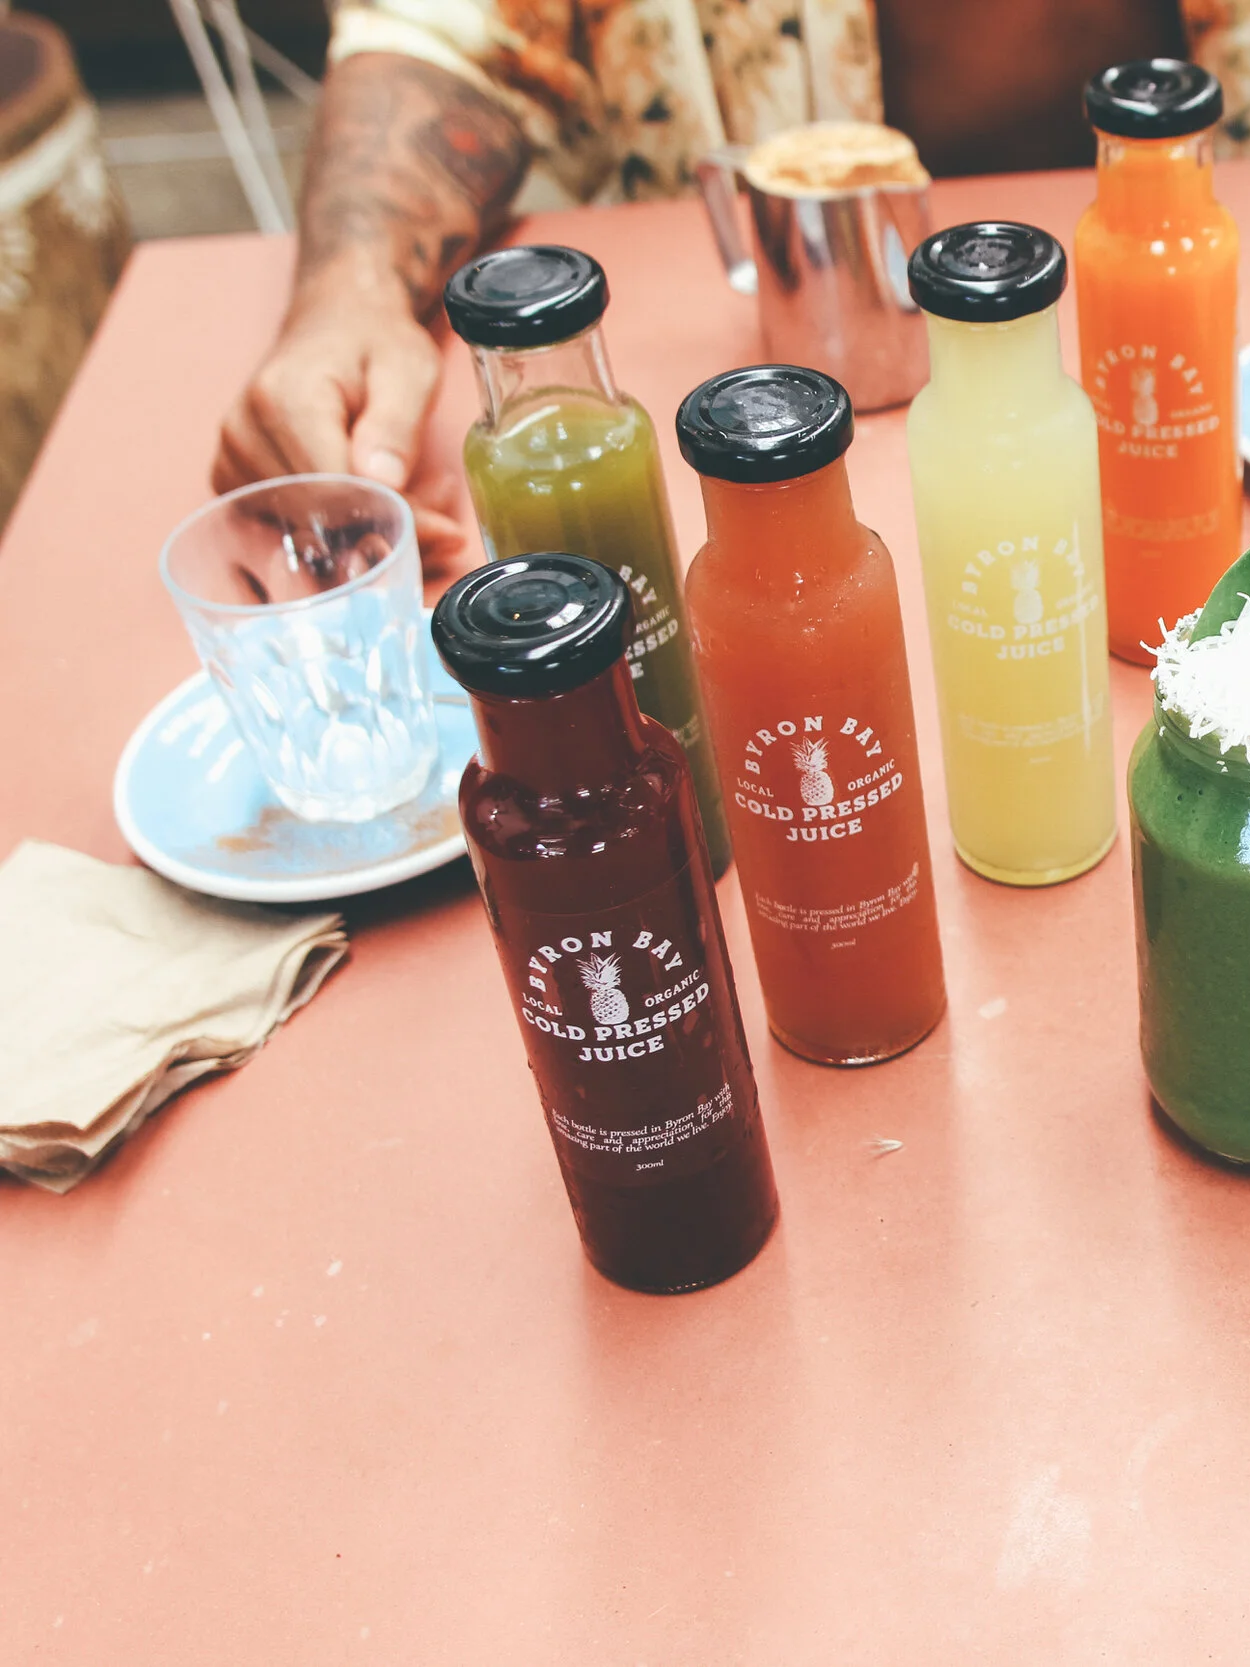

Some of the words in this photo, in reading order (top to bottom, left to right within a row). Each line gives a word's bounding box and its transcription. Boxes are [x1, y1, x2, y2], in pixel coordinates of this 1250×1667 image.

[1170, 354, 1204, 394] BAY
[1097, 412, 1125, 435] OLD
[1132, 415, 1220, 440] PRESSED
[1118, 441, 1178, 458] JUICE
[962, 537, 1038, 595] BYRON
[635, 605, 670, 635] RGANIC
[948, 614, 1005, 639] COLD
[996, 636, 1065, 660] JUICE
[745, 716, 823, 775] BYRON
[840, 717, 882, 758] BAY
[737, 777, 774, 798] LOCAL
[847, 758, 896, 791] ORGANIC
[735, 792, 794, 821] COLD
[802, 772, 903, 822] PRESSED
[786, 818, 863, 842] JUICE
[809, 905, 844, 917] pressed
[528, 931, 612, 992] BYRON
[632, 931, 683, 971] BAY
[522, 992, 562, 1016] LOCAL
[644, 969, 700, 1008] ORGANIC
[522, 1007, 586, 1041] COLD
[594, 982, 709, 1041] PRESSED
[579, 1034, 665, 1062] JUICE
[571, 1119, 597, 1135] bottle
[599, 1127, 608, 1136] is
[610, 1124, 648, 1139] pressed
[651, 1125, 661, 1134] in
[665, 1112, 695, 1130] Byron
[697, 1099, 713, 1115] Bay
[714, 1082, 730, 1102] with
[576, 1130, 595, 1141] care
[603, 1136, 623, 1146] and
[632, 1121, 694, 1146] appreciation
[701, 1107, 714, 1123] for
[589, 1142, 610, 1151] part
[611, 1145, 622, 1154] of
[625, 1143, 642, 1153] the
[644, 1135, 675, 1151] world
[676, 1131, 691, 1142] we
[692, 1121, 709, 1136] live.
[636, 1159, 665, 1172] 300ml
